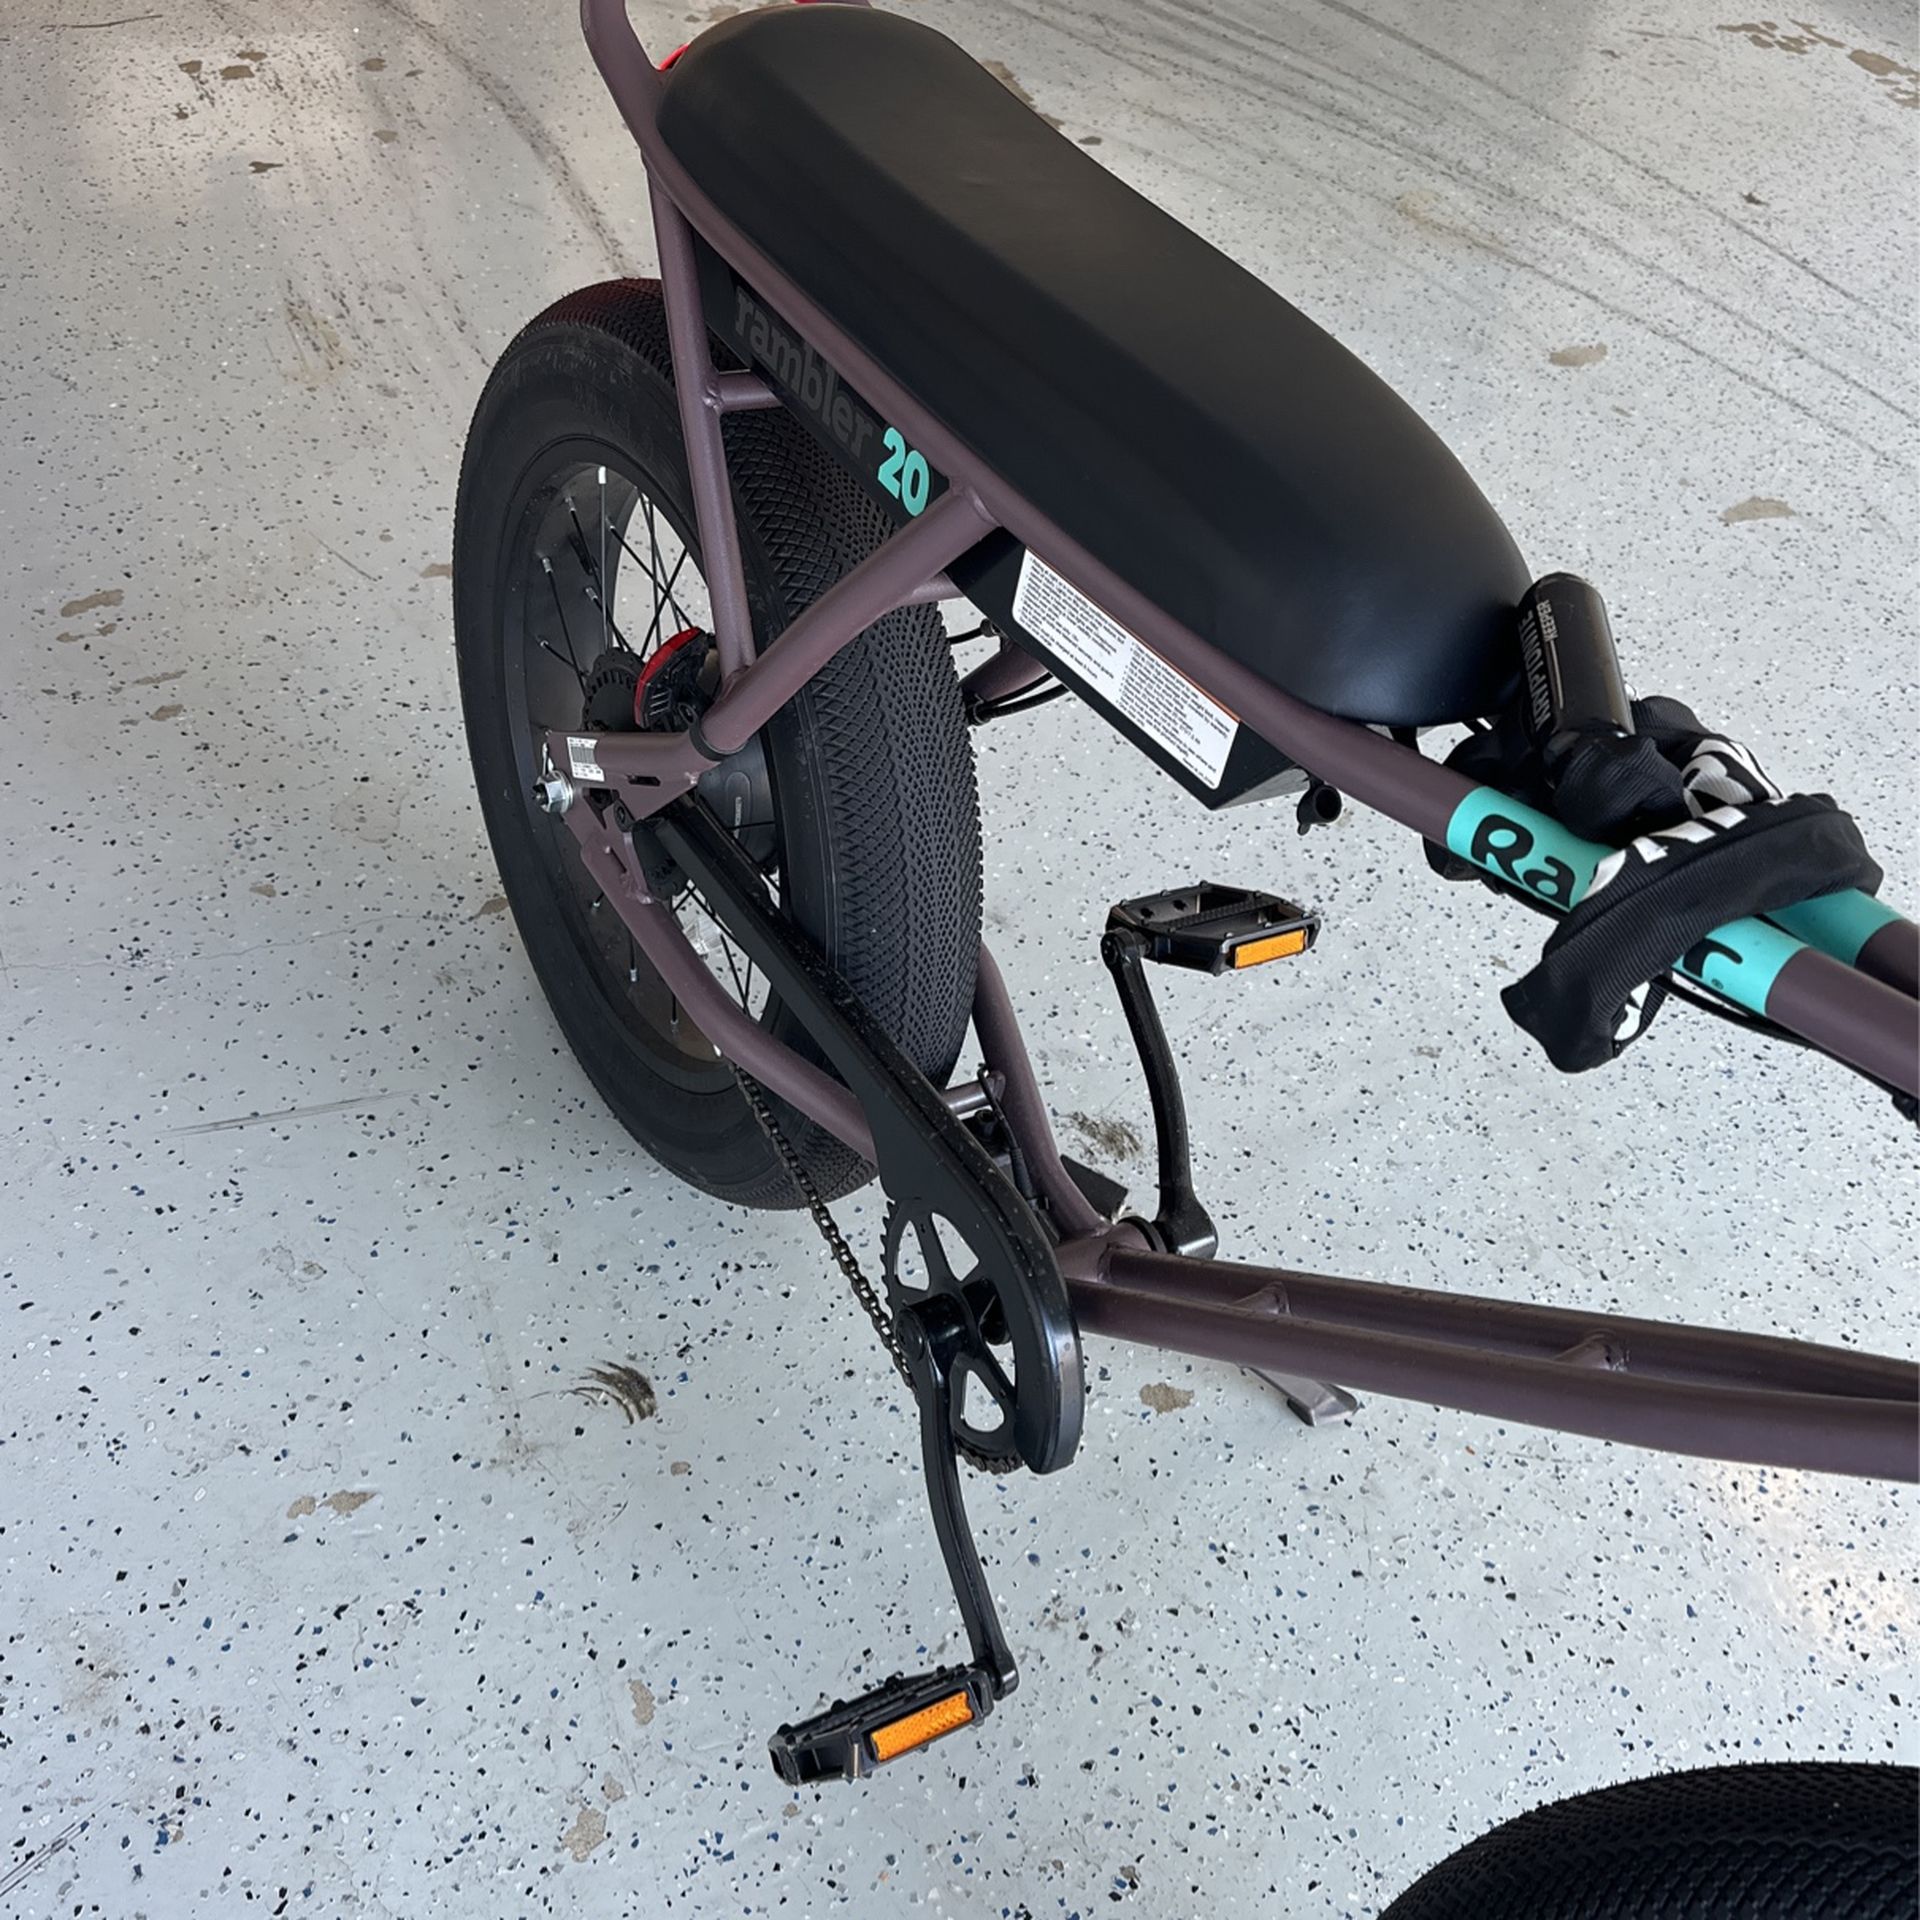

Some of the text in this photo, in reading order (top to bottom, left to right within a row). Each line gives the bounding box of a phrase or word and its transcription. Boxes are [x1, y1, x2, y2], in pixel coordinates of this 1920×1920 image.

[735, 286, 930, 517] rambler 20
[1518, 609, 1551, 732] KRYPTONITE
[1536, 599, 1558, 642] KEEPER
